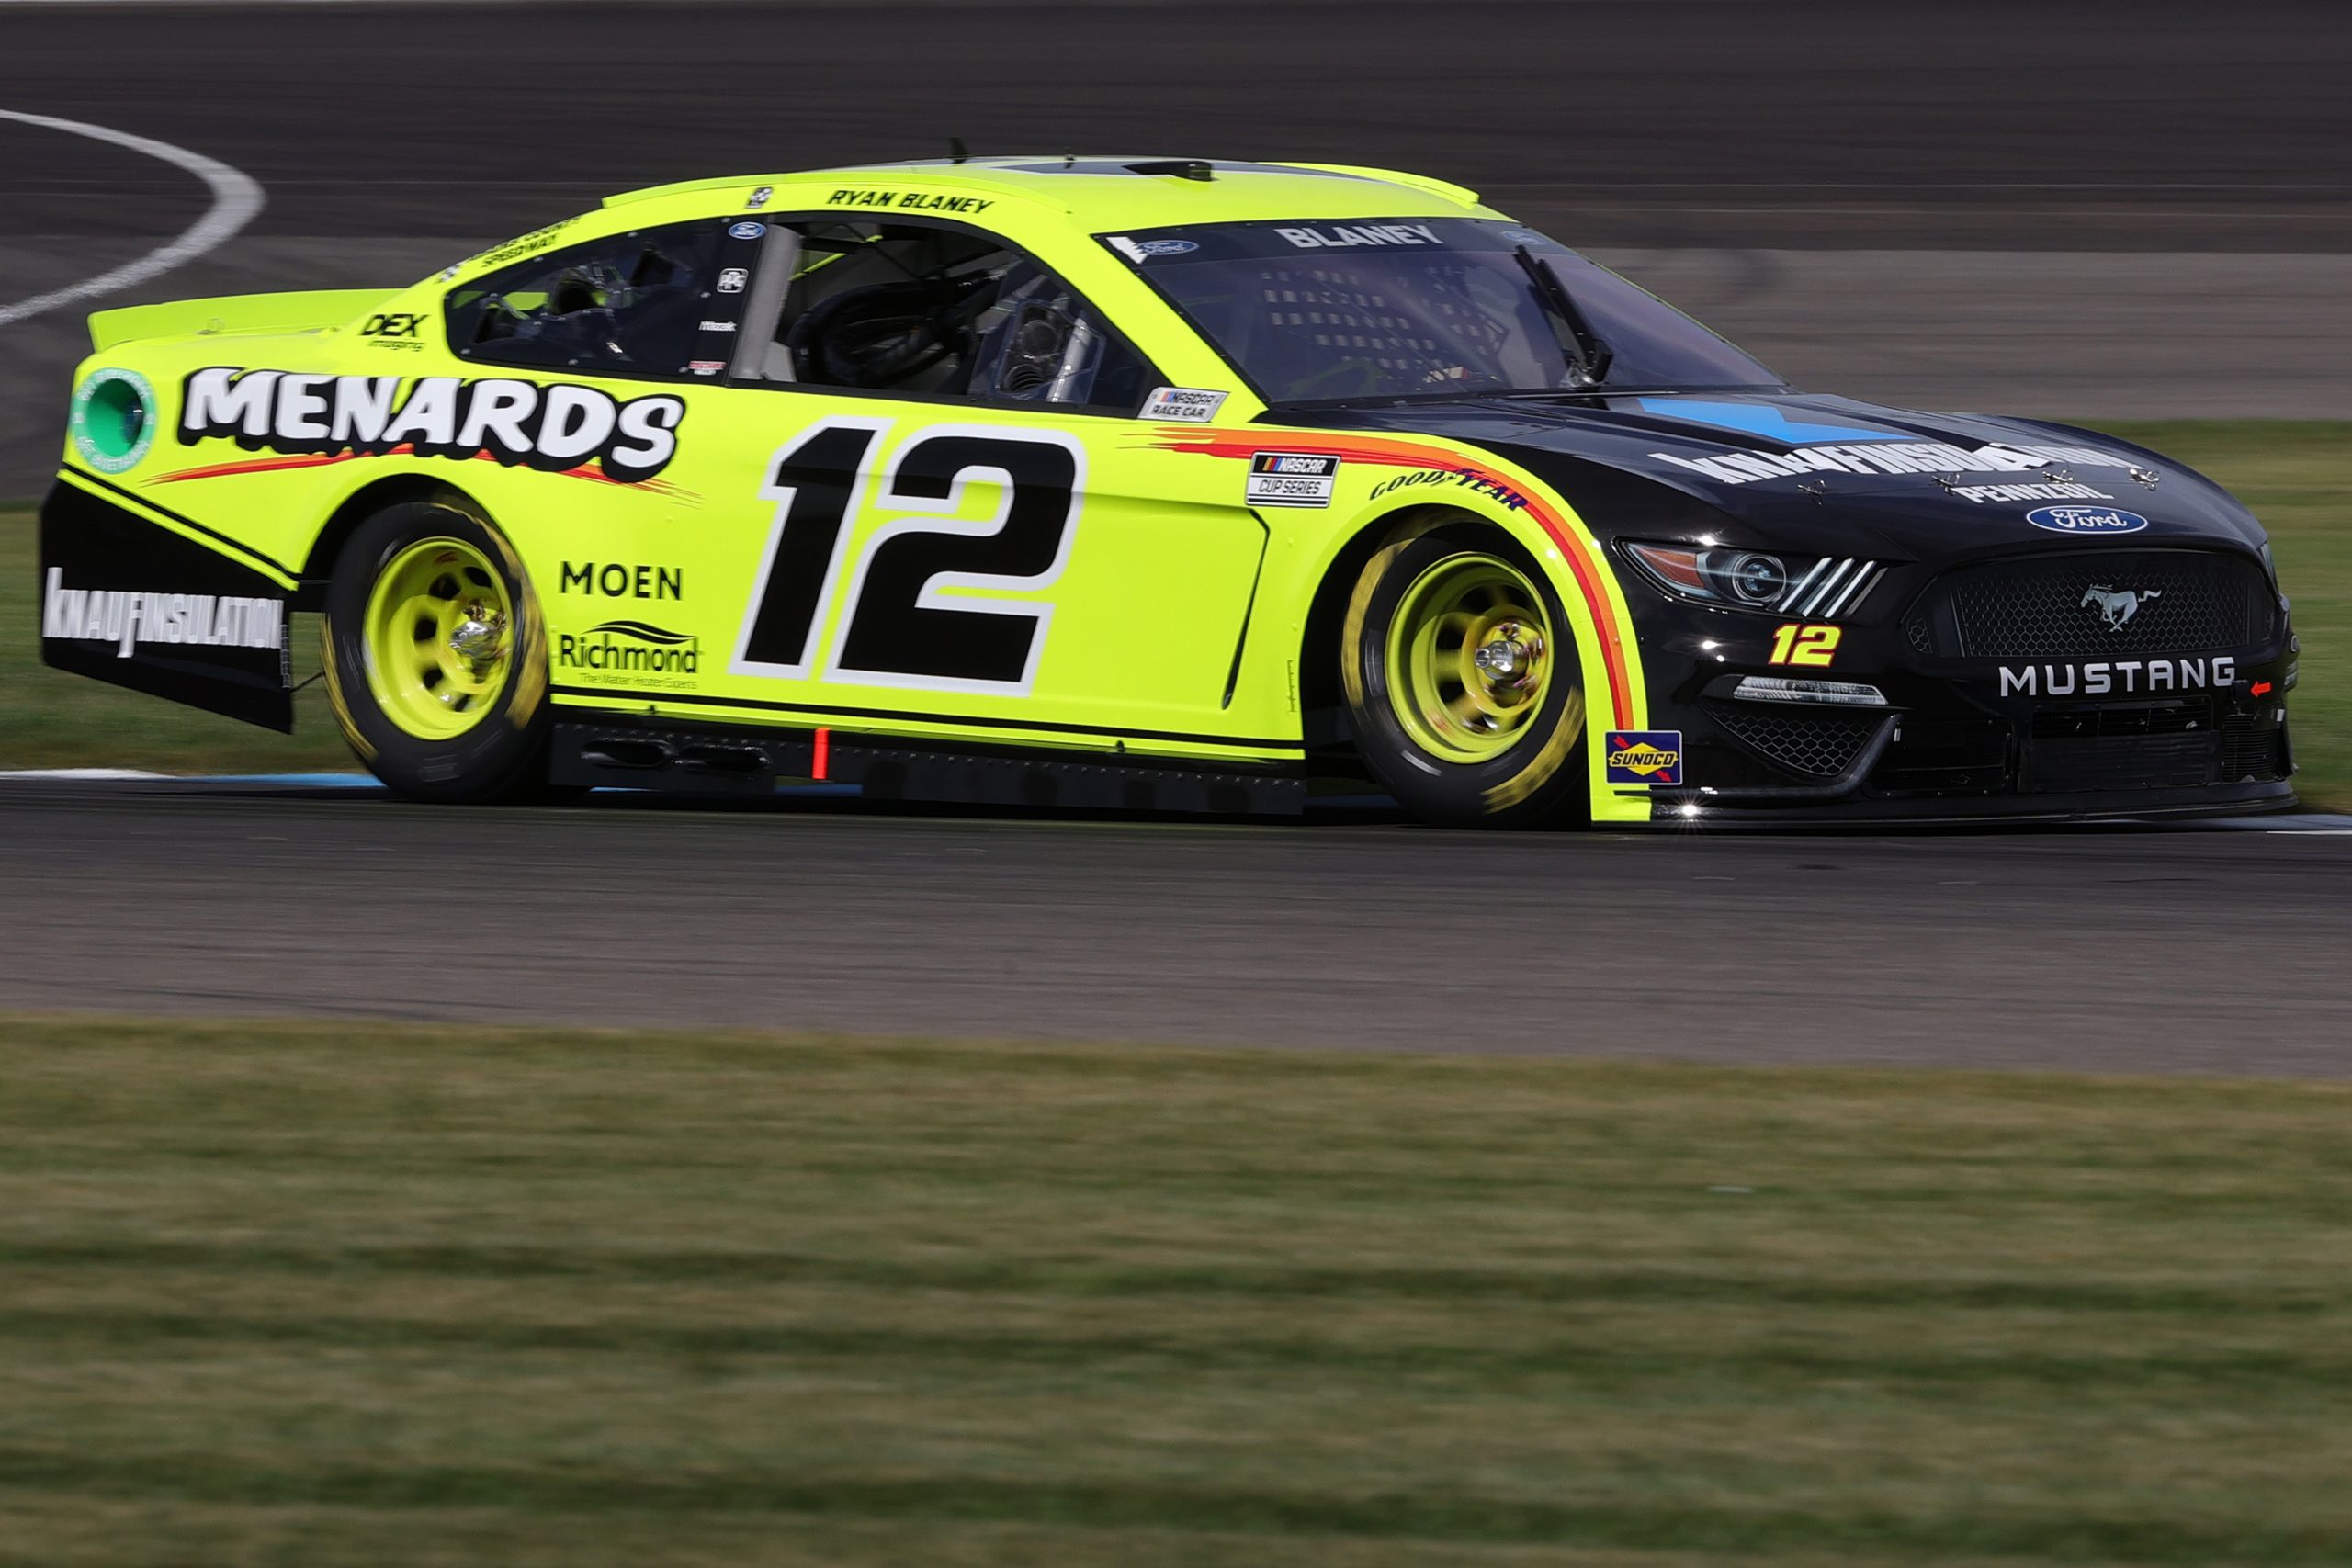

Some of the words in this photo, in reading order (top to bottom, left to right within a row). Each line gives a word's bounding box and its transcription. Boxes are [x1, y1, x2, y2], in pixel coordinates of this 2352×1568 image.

[828, 190, 897, 206] RYAN
[899, 194, 994, 213] BLANEY
[1273, 225, 1443, 247] BLANEY
[358, 313, 429, 337] DEX
[1173, 392, 1216, 406] NASCAR
[1152, 404, 1182, 416] RACE
[1182, 406, 1205, 418] CAR
[179, 367, 685, 483] MENARDS
[1278, 457, 1327, 473] NASCAR
[1259, 479, 1283, 493] CUP
[1283, 480, 1321, 494] SERIES
[1951, 483, 2114, 503] PENNZOIL
[728, 414, 1088, 698] 12
[560, 560, 682, 601] MOEN
[559, 633, 699, 673] Richmond
[1769, 625, 1842, 668] 12
[2000, 656, 2235, 697] MUSTANG
[1611, 753, 1675, 766] SUNOCO
